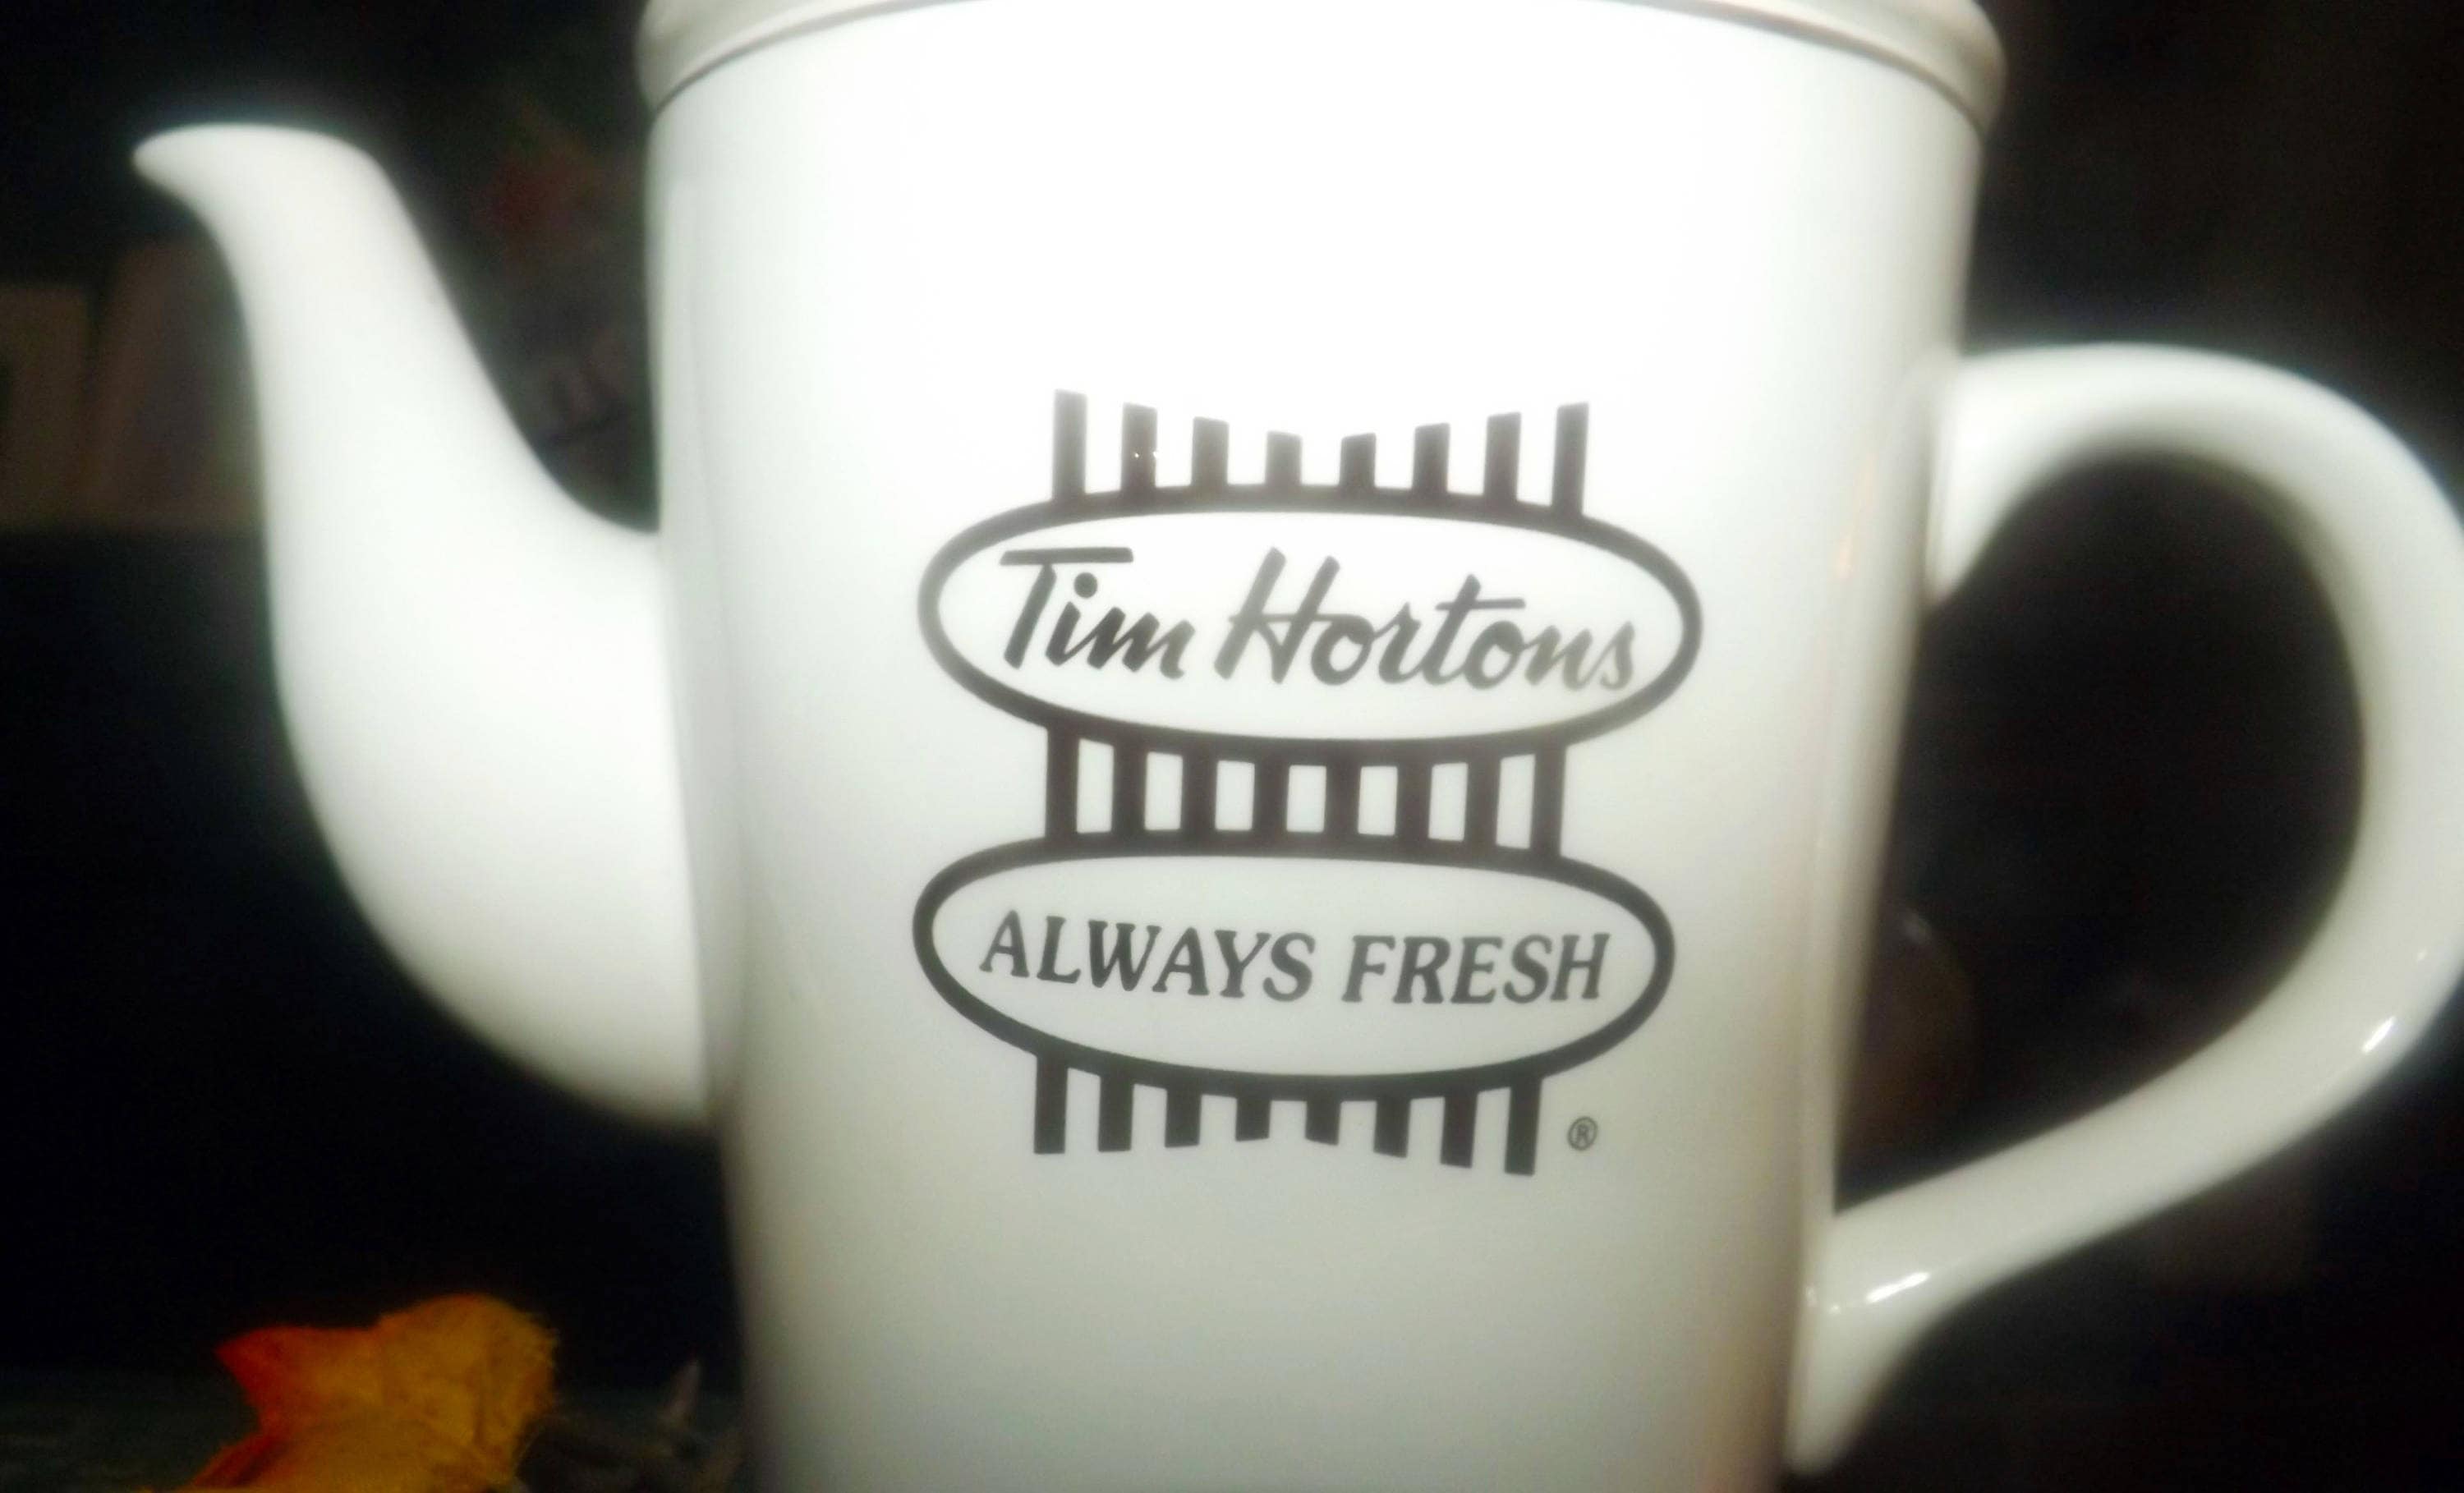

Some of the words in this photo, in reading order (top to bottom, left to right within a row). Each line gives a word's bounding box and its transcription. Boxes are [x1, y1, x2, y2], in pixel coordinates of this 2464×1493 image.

[1000, 547, 1195, 680] Tim
[1214, 547, 1634, 690] Hortons
[980, 911, 1315, 1002] ALWAYS
[1341, 933, 1611, 1005] FRESH
